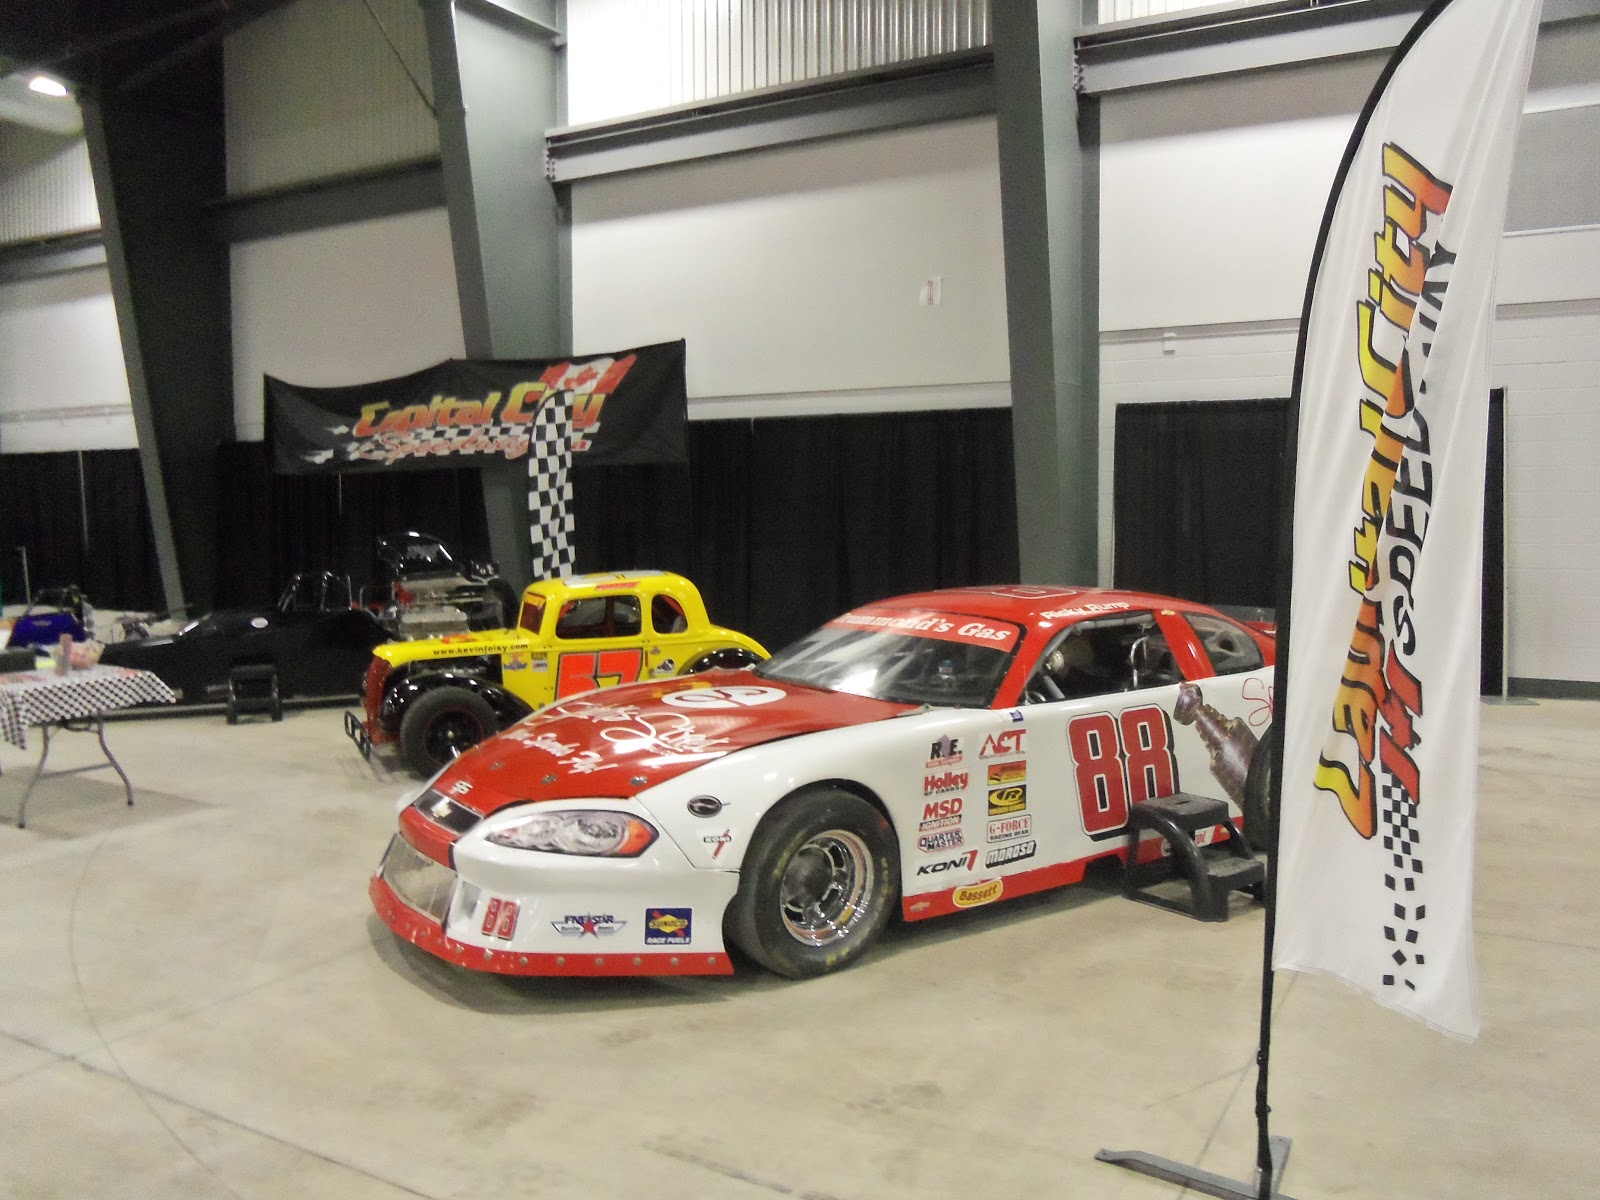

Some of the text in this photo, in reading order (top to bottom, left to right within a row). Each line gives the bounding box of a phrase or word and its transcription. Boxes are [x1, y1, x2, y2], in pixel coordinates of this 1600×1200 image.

[1356, 141, 1454, 419] City
[353, 391, 501, 437] Capital
[957, 622, 1012, 641] Gas
[979, 729, 1027, 757] ACT
[923, 771, 969, 793] Holley
[1066, 703, 1181, 842] 88
[923, 797, 963, 820] MSD
[989, 818, 1030, 835] G-FORCE
[920, 830, 961, 847] QUARTER
[927, 837, 963, 851] MASTER
[917, 856, 968, 876] KONI
[959, 884, 998, 901] Bassett
[481, 897, 520, 941] 88
[592, 914, 614, 924] STAR
